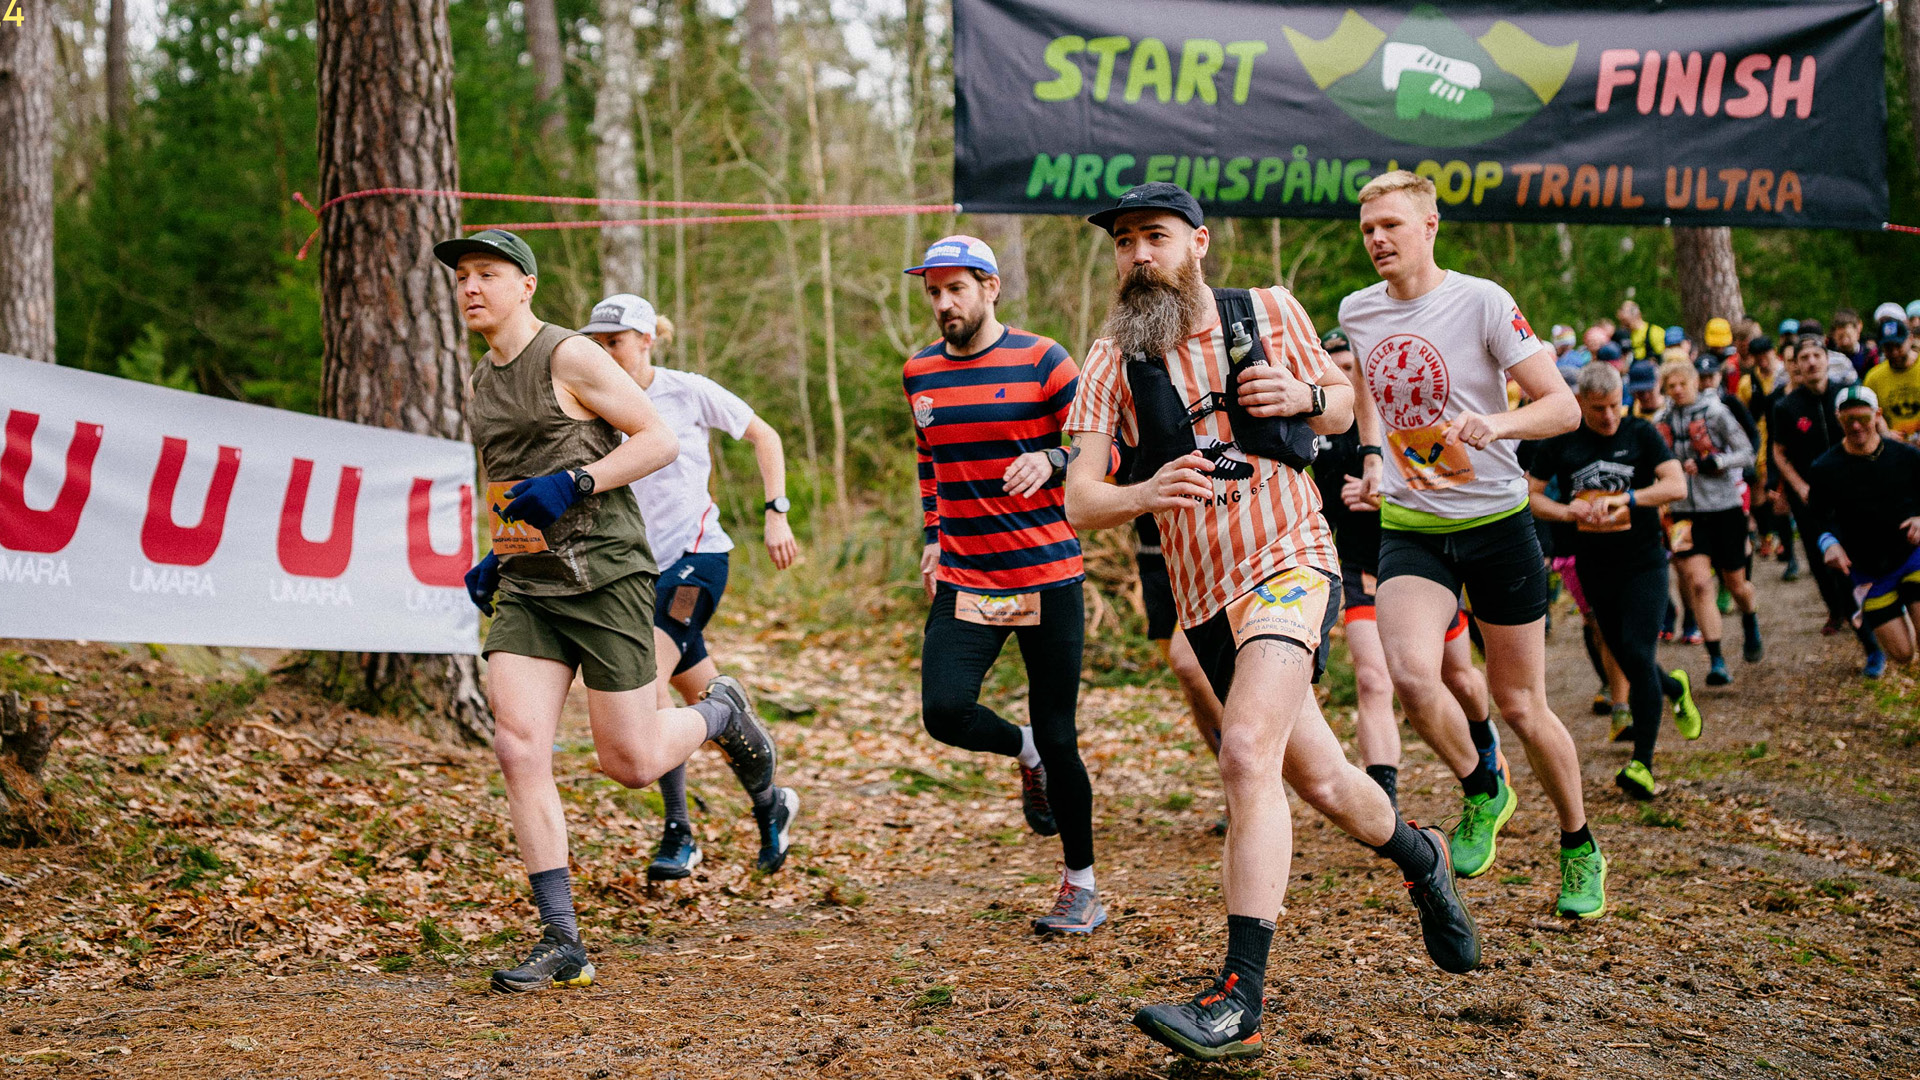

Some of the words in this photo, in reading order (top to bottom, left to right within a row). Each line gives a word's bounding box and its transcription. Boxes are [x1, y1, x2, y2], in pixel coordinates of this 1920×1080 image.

[1033, 34, 1268, 105] START
[1594, 49, 1817, 120] FINISH
[1025, 152, 1136, 200] MRC
[1386, 159, 1502, 204] OOP
[1512, 163, 1645, 209] TRAIL
[1665, 166, 1803, 213] ULTRA
[1418, 345, 1444, 401] RUNNING
[1394, 414, 1424, 427] CLUB
[0, 554, 72, 587] MARA
[129, 565, 216, 597] UMARA
[269, 578, 354, 608] UMARA
[1271, 616, 1289, 624] LOOP
